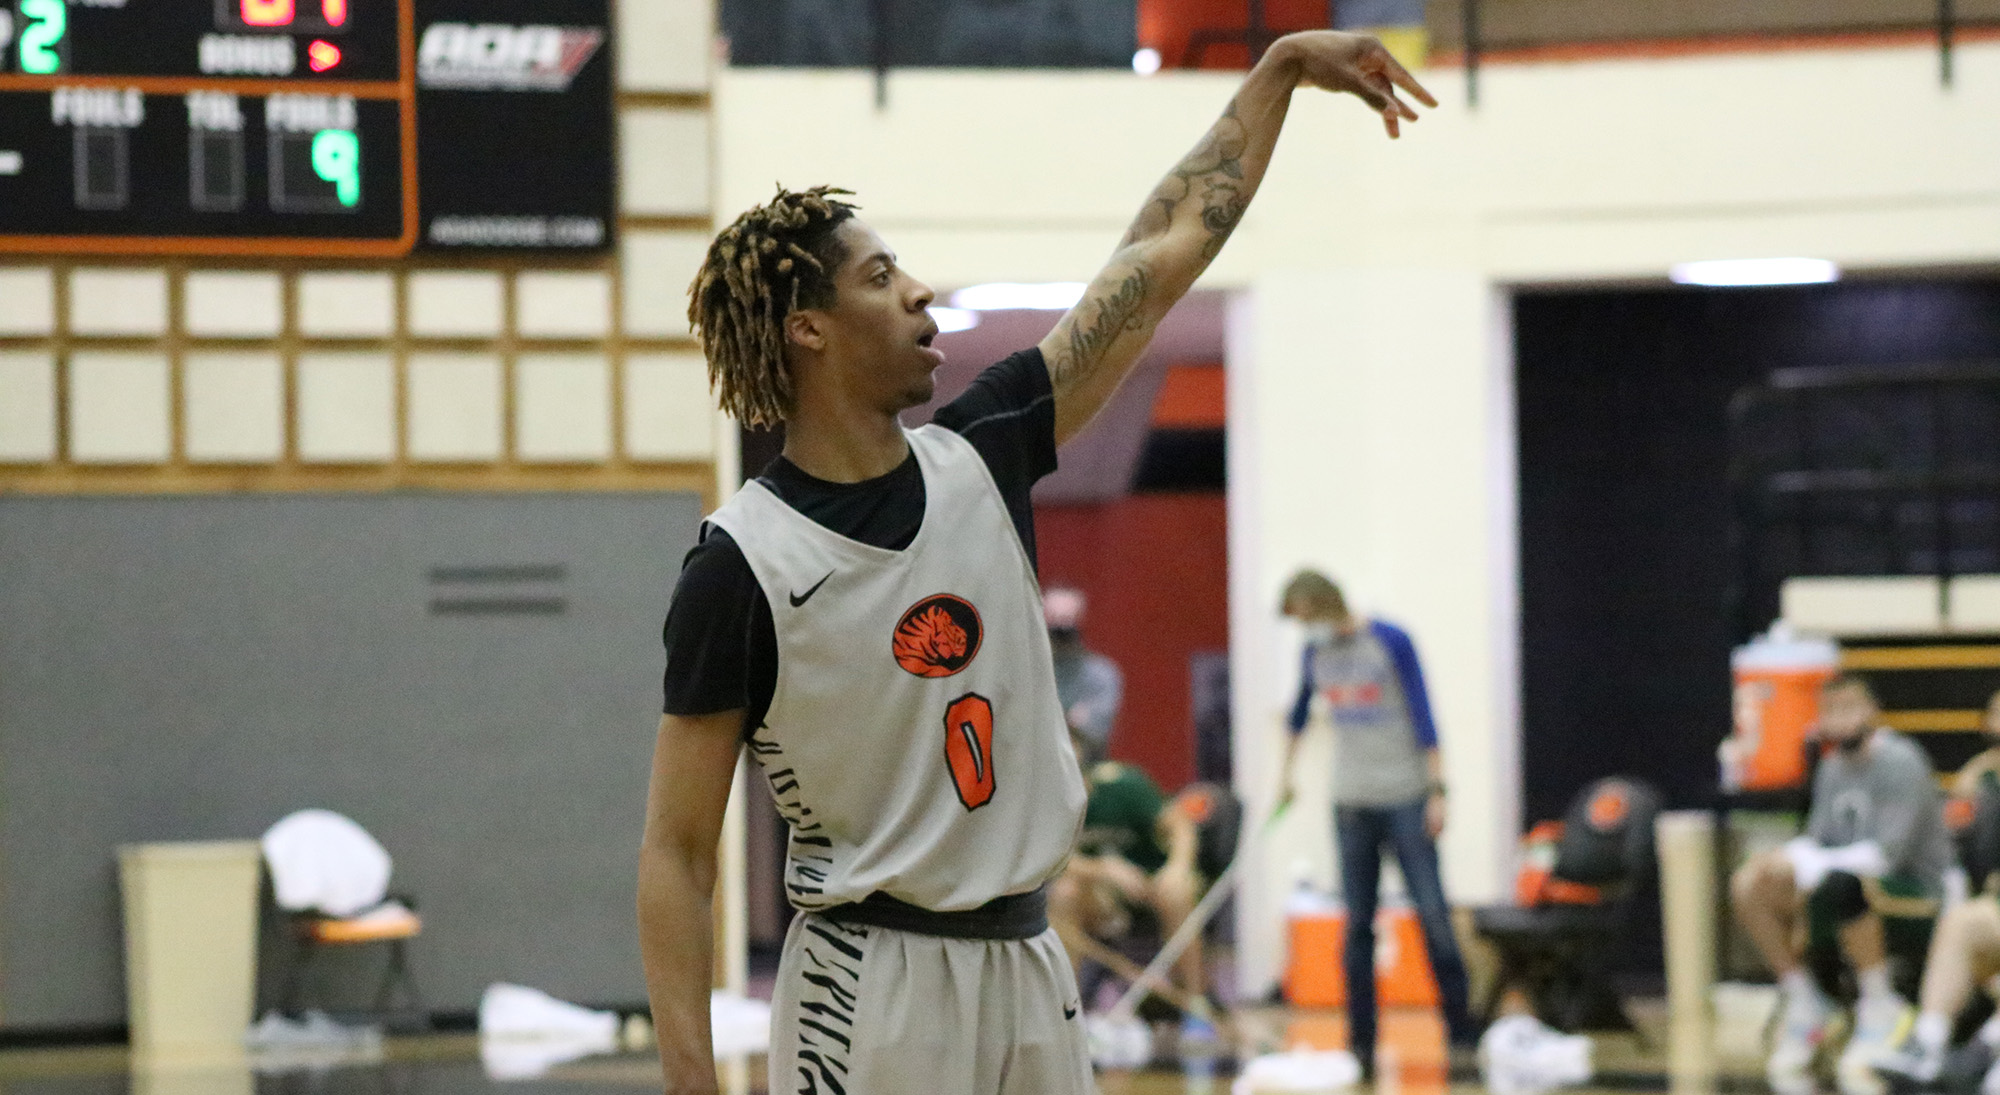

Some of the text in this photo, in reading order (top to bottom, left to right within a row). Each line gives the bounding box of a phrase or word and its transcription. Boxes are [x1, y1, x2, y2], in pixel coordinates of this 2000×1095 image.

[199, 34, 296, 75] BONUS
[52, 87, 145, 127] FOULS
[266, 92, 357, 132] FOULS
[311, 129, 360, 207] 9
[943, 692, 997, 813] 0
